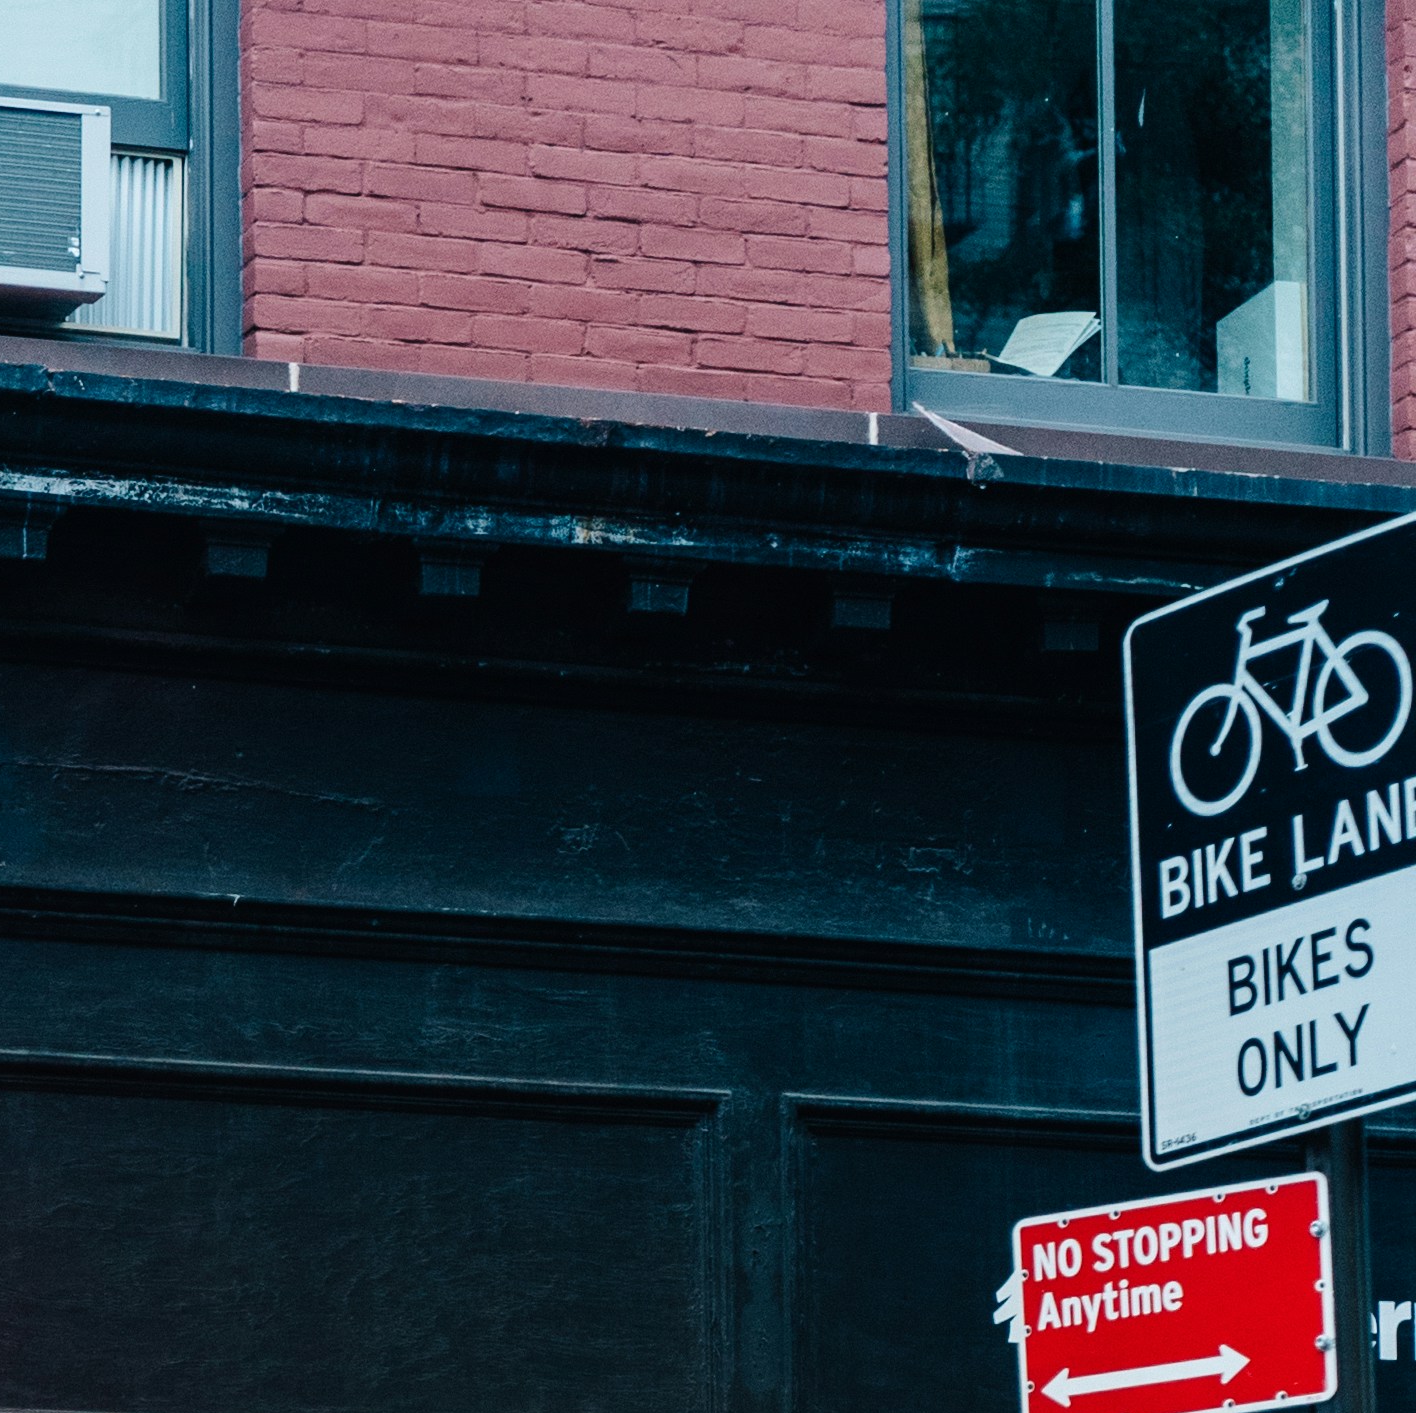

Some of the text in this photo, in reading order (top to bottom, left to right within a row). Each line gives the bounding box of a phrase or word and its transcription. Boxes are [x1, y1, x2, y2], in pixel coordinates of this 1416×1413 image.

[1159, 826, 1271, 919] BIKE
[1227, 918, 1374, 1017] BIKES
[1238, 1003, 1371, 1097] ONLY
[1032, 1208, 1269, 1282] NO STOPPING
[1037, 1279, 1184, 1333] Anytime
